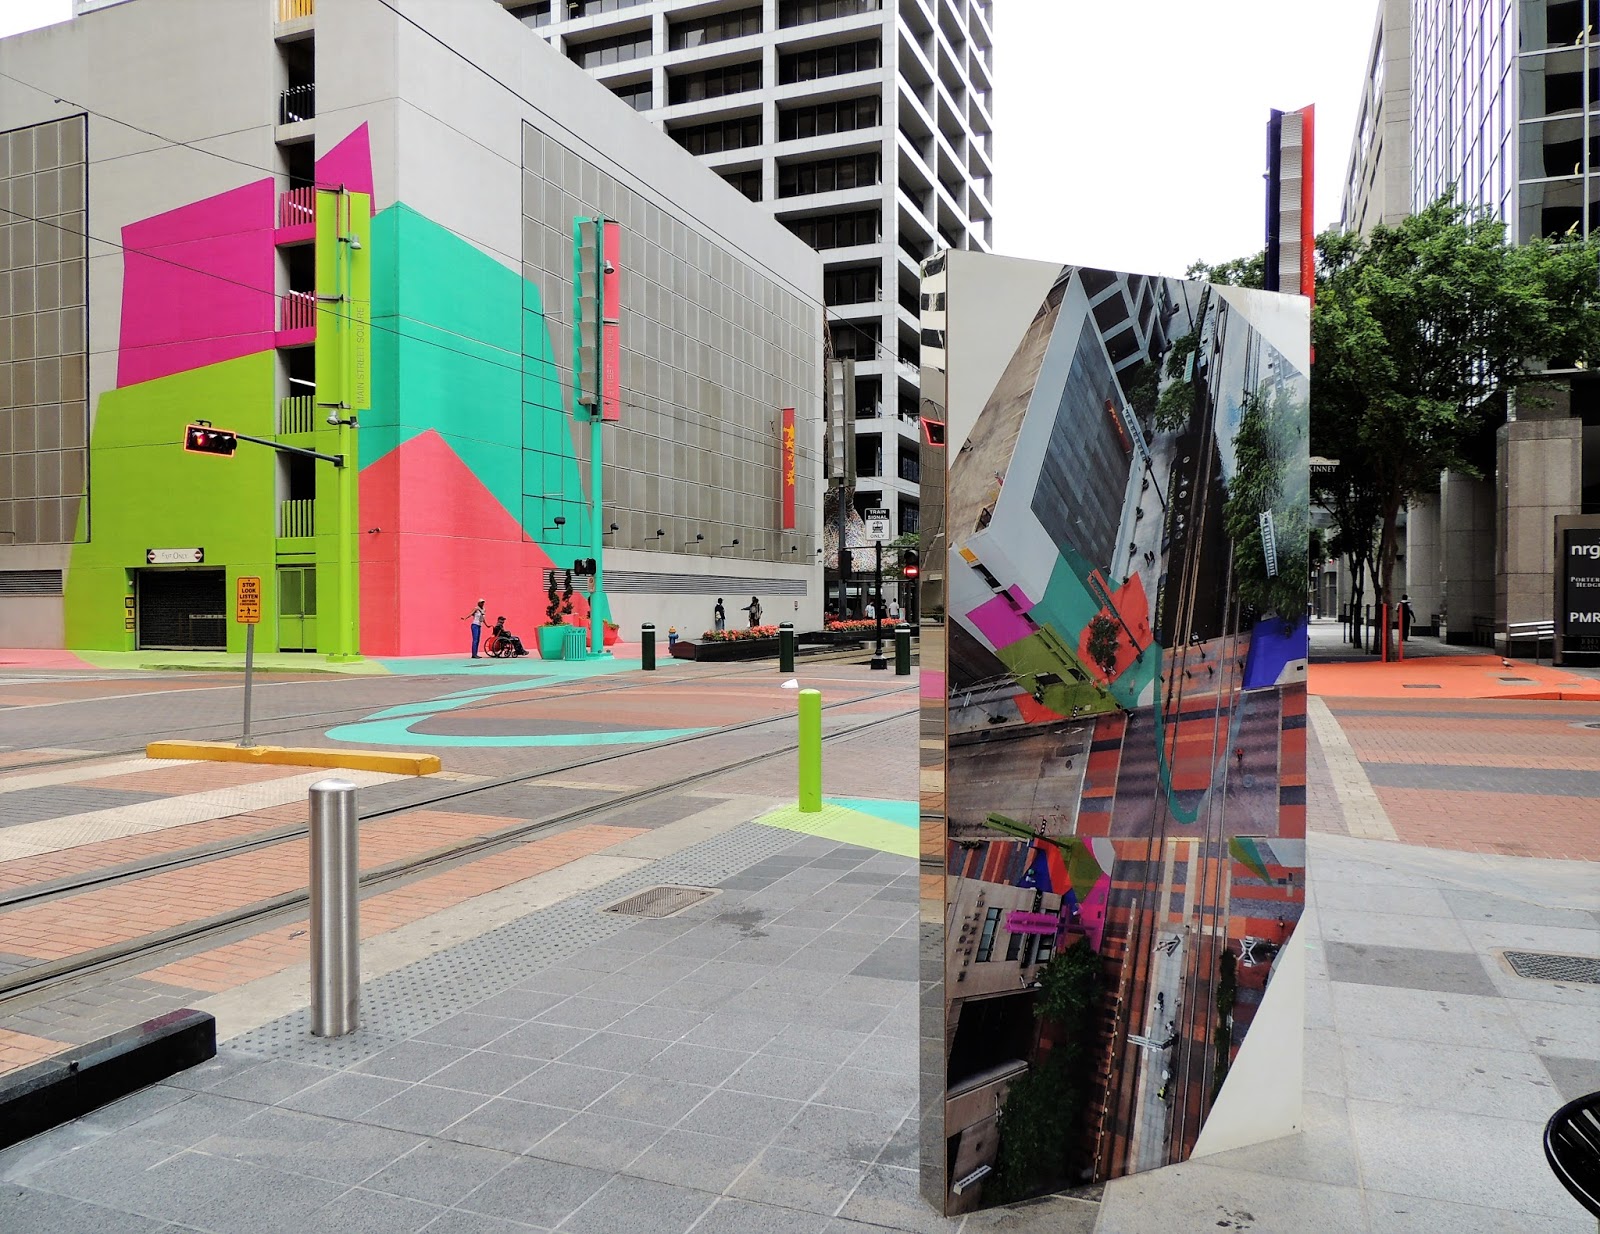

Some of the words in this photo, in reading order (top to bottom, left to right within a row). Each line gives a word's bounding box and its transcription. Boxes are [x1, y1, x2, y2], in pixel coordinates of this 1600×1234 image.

[356, 346, 365, 380] STREET
[356, 382, 365, 404] MAIN
[1571, 545, 1600, 560] nrg
